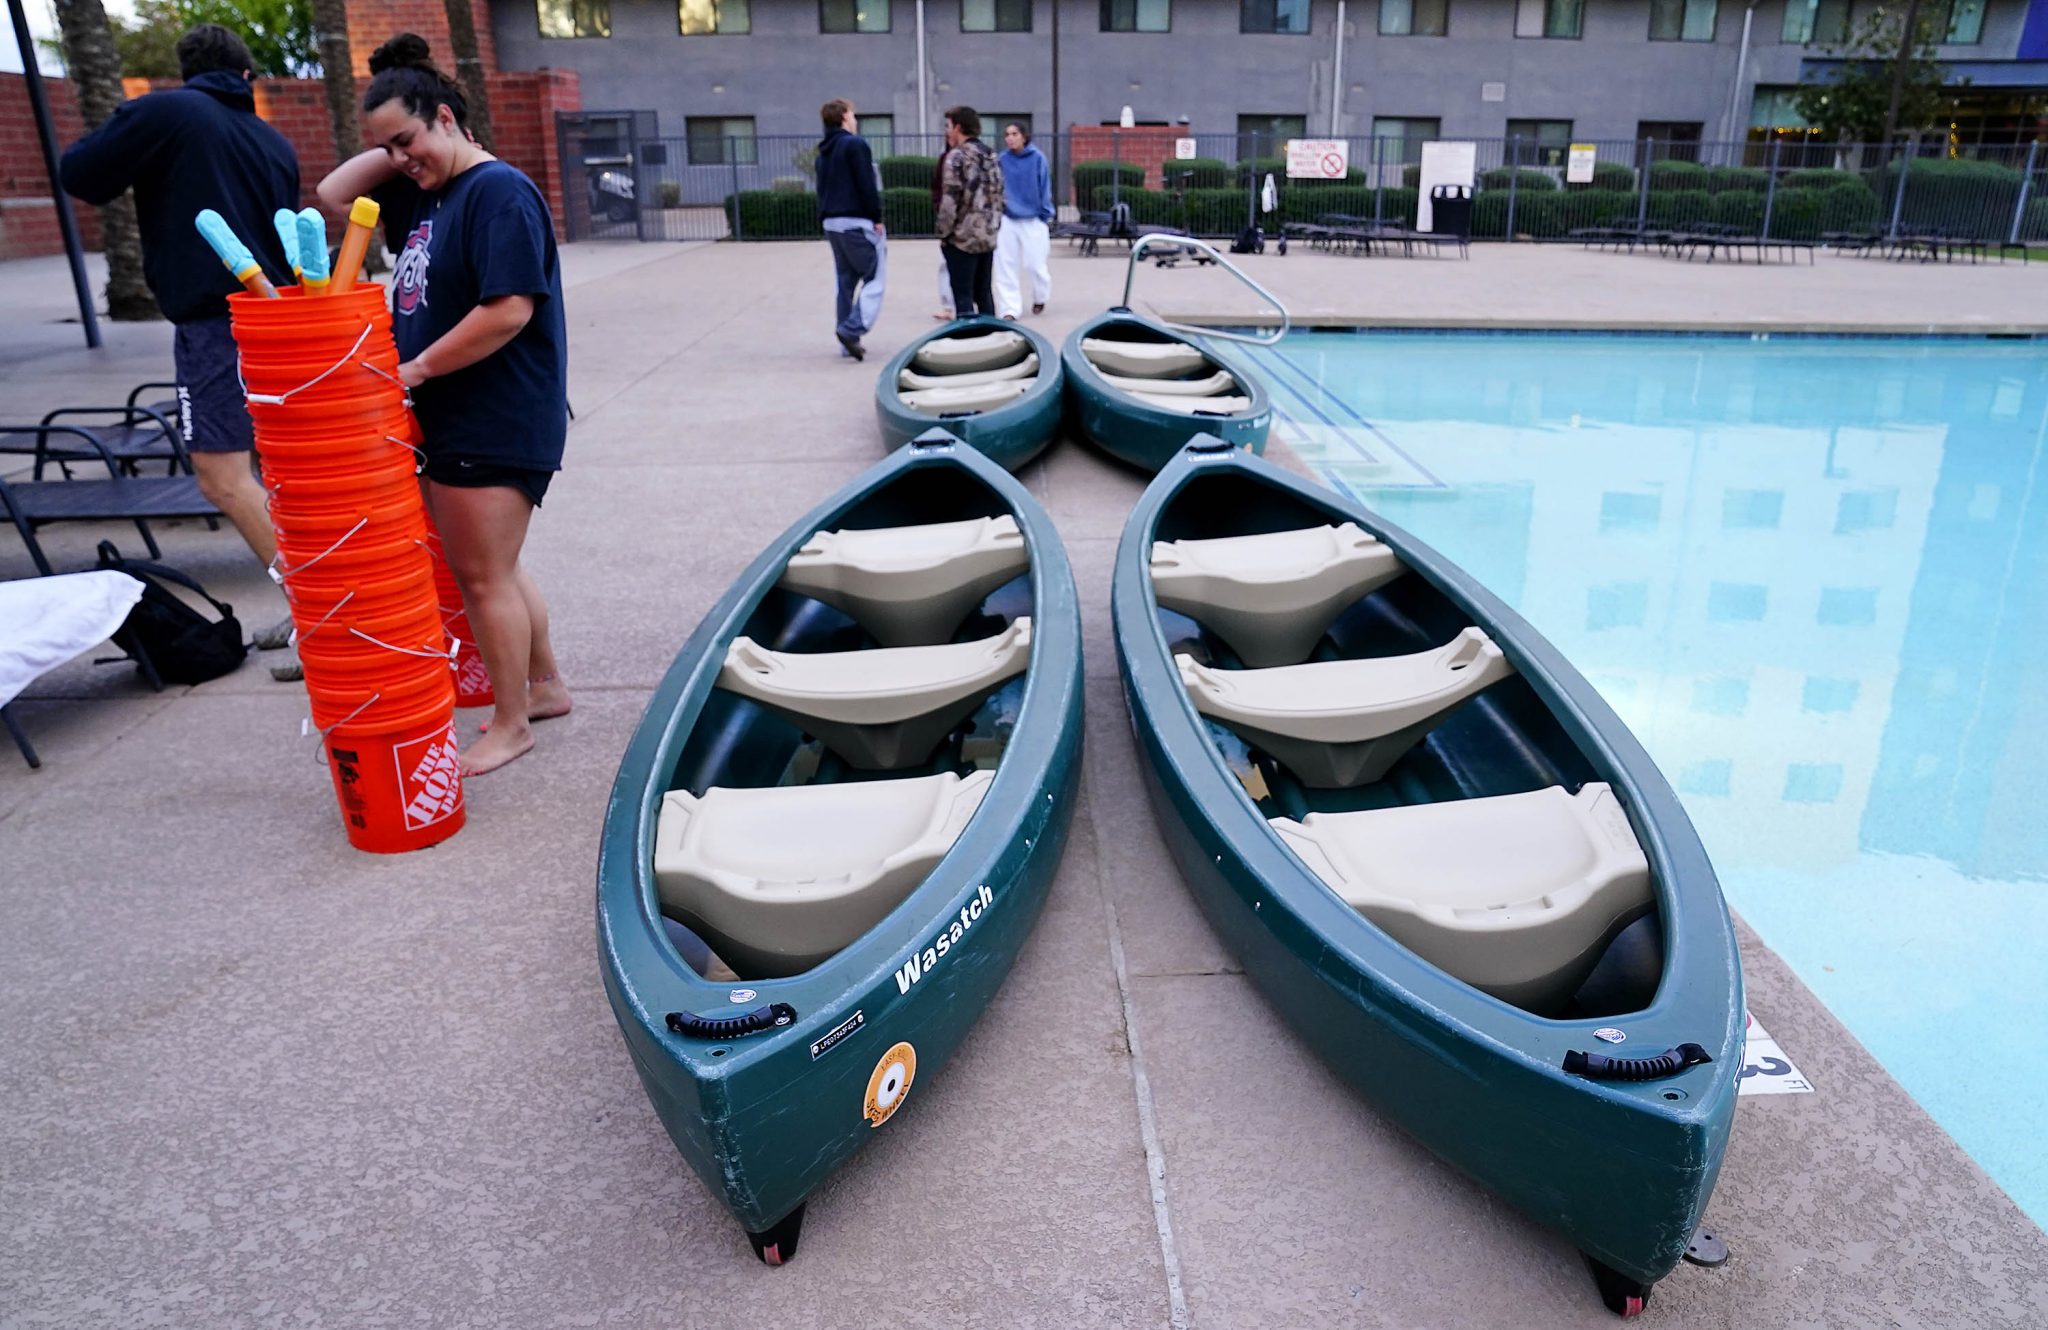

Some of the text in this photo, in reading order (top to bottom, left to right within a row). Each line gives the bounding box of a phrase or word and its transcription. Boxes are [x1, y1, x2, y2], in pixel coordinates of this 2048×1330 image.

[410, 743, 442, 783] THE
[894, 884, 994, 995] Wasatch
[1735, 1056, 1792, 1084] 3
